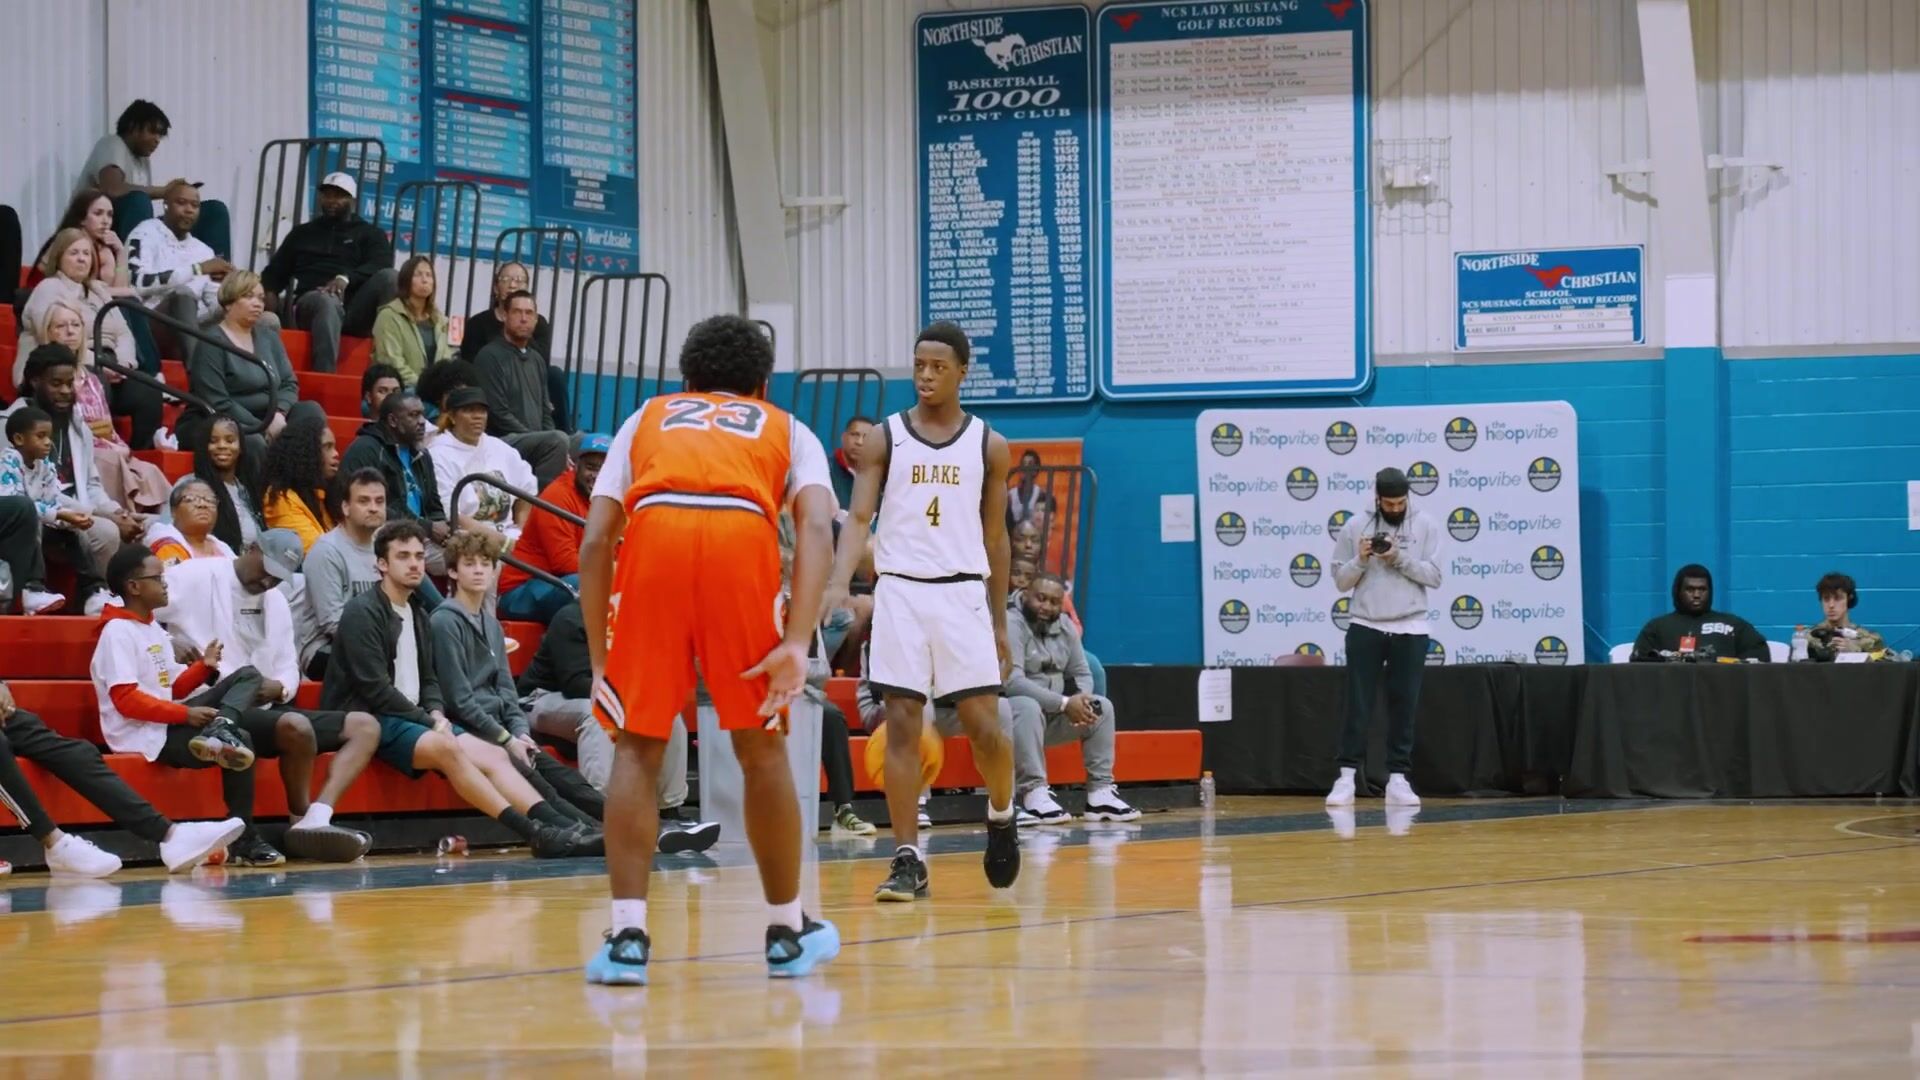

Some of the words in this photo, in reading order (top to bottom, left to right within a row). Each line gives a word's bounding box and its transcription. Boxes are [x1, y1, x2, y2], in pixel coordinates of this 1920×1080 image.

[1161, 6, 1187, 19] NCS
[1192, 4, 1228, 17] LADY
[1232, 0, 1298, 13] MUSTANG
[923, 17, 1003, 46] NORTHSIDE
[1177, 19, 1214, 31] GOLF
[1218, 16, 1283, 29] RECORDS
[1012, 35, 1082, 67] CHRISTIAN
[948, 75, 1059, 91] BASKETBALL
[948, 87, 1061, 112] 1000
[937, 112, 1002, 123] POINT
[1014, 108, 1071, 119] CLUB
[1461, 254, 1540, 272] NORTHSIDE
[1561, 271, 1637, 289] CHRISTIAN
[1462, 301, 1480, 309] NCS
[1481, 300, 1522, 308] MUSTANG
[1523, 298, 1551, 306] CROSS
[1552, 296, 1595, 305] COUNTRY
[1596, 295, 1637, 303] RECORDS
[1525, 290, 1572, 298] SCHOOL
[660, 398, 768, 439] 23
[1250, 430, 1320, 449] hoopvibe
[1366, 428, 1438, 449] hoopvibe
[1485, 423, 1558, 444] hoopvibe
[911, 464, 960, 485] BLAKE
[1215, 472, 1228, 480] the
[1449, 471, 1522, 491] hoopvibe
[1455, 468, 1469, 476] the
[1209, 476, 1279, 496] hoopvibe
[1327, 476, 1375, 495] hoopv
[926, 496, 940, 527] 4
[1253, 519, 1322, 539] hoopvibe
[1489, 514, 1561, 534] hoopvibe
[1219, 560, 1232, 568] the
[1452, 560, 1524, 579] hoopvibe
[1214, 564, 1282, 584] hoopvibe
[1257, 608, 1326, 627] hoopvibe
[1263, 604, 1276, 612] the
[1492, 602, 1565, 622] hoopvibe
